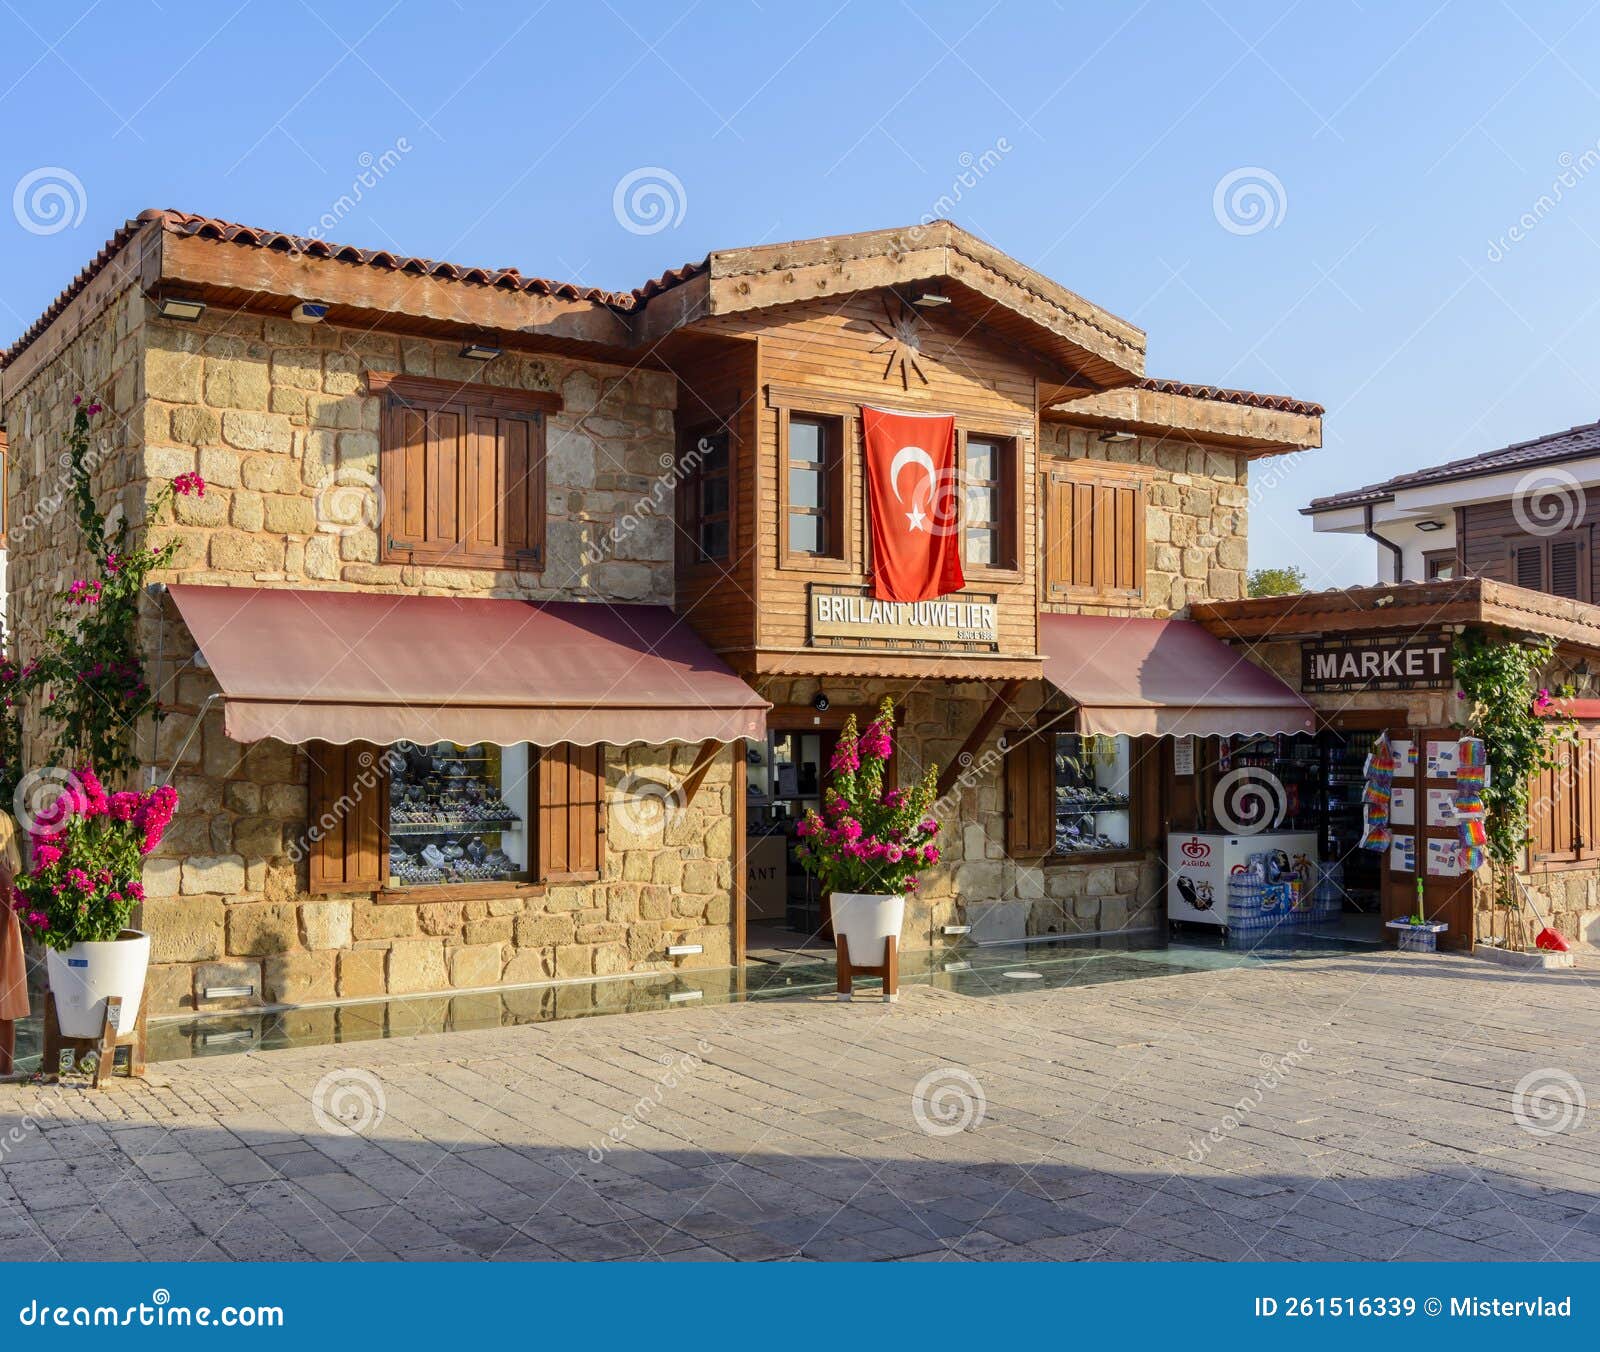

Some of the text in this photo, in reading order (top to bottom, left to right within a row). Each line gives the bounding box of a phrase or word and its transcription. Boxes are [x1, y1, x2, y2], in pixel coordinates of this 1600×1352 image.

[818, 595, 993, 629] BRILLANT JUWELIER
[1316, 648, 1446, 680] MARKET
